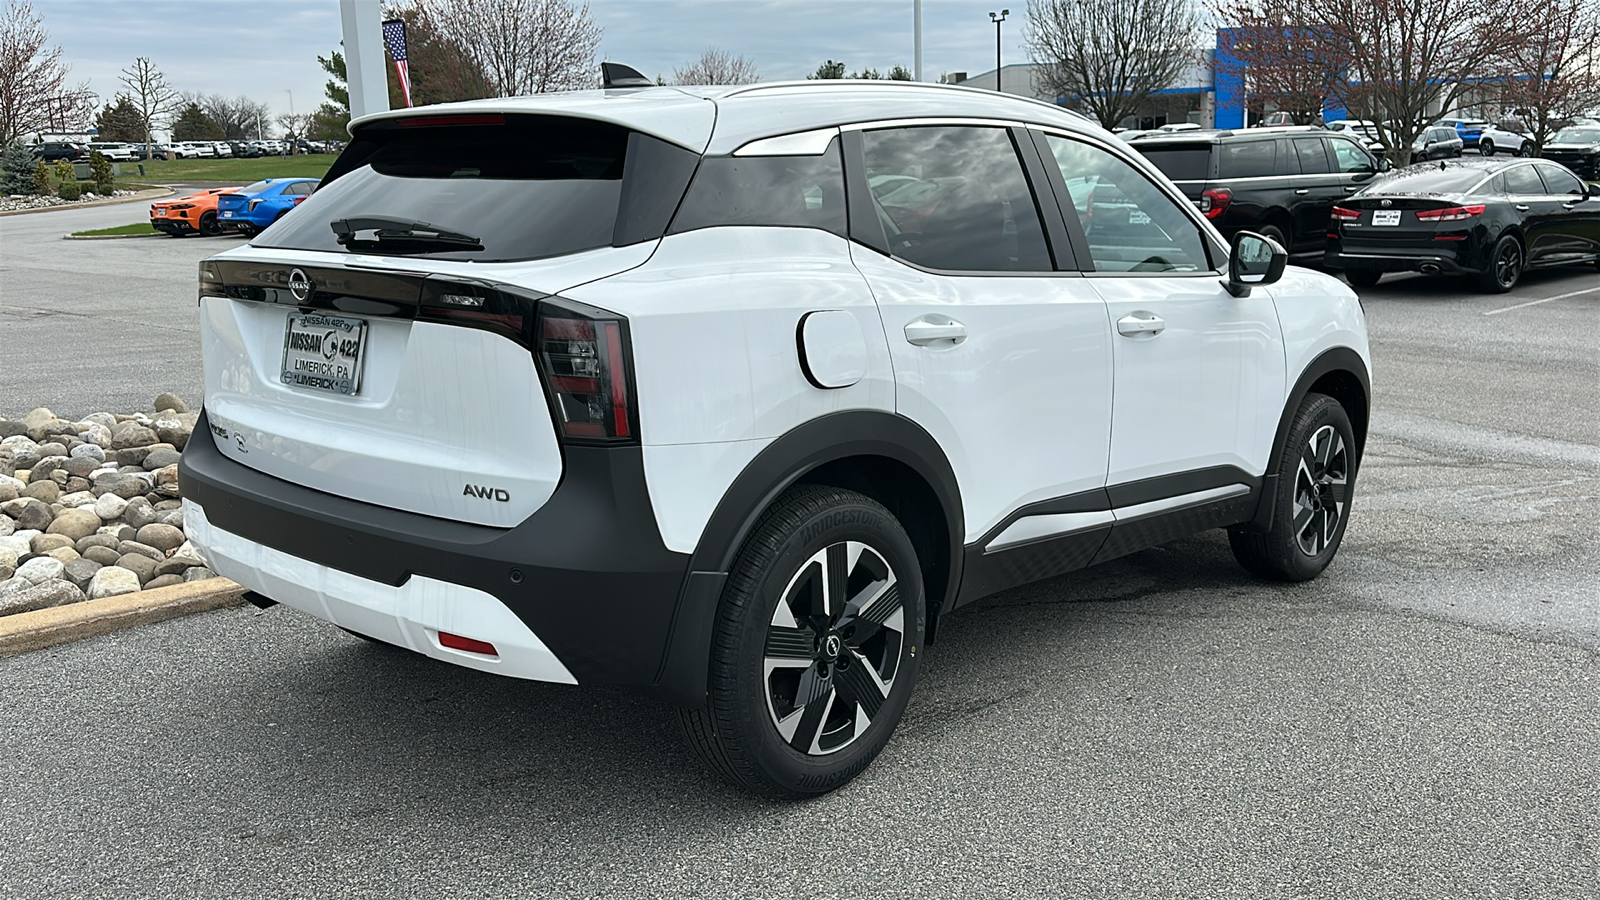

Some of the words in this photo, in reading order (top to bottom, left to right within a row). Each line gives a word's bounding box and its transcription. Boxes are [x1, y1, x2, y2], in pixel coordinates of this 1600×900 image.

[304, 316, 331, 326] NISSAN
[331, 319, 345, 327] 422
[290, 332, 322, 353] NISSAN
[339, 339, 358, 358] 422
[295, 359, 335, 377] LIMERICK,
[337, 366, 349, 379] PA
[296, 374, 335, 390] LIMERICK
[463, 484, 510, 502] AWD
[800, 509, 883, 547] BRIDGESTONE
[795, 741, 879, 788] BRIDGESTONE
